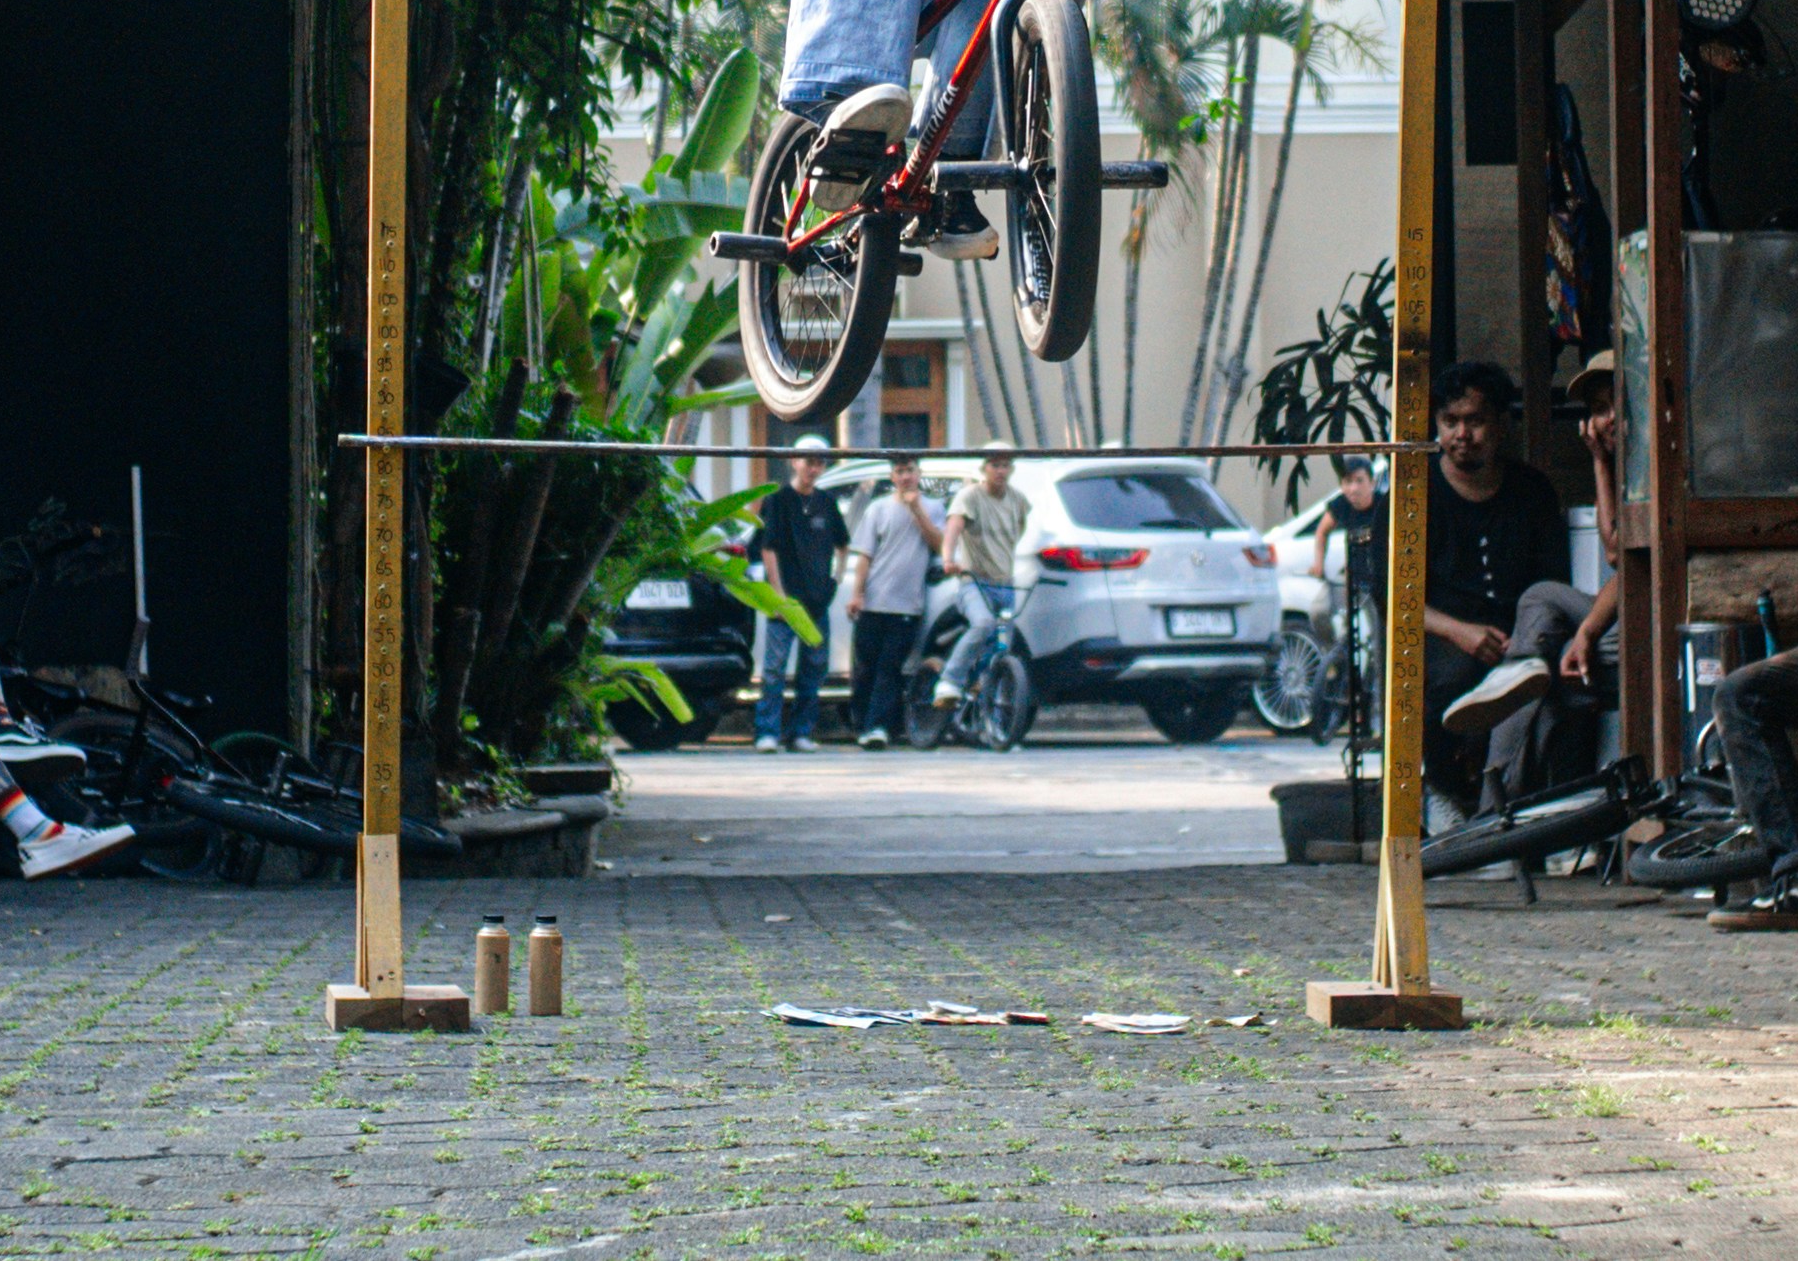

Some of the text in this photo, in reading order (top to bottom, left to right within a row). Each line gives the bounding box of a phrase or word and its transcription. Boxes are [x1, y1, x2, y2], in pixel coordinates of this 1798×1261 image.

[379, 258, 396, 272] 110
[1406, 266, 1426, 281] 110
[1404, 300, 1425, 315] 105
[378, 325, 399, 338] 100
[377, 357, 393, 373] 95
[376, 494, 394, 510] 75
[375, 528, 393, 542] 70
[1401, 530, 1419, 545] 70
[376, 560, 393, 576] 65
[1399, 563, 1419, 578] 65
[374, 594, 393, 609] 60
[373, 628, 396, 644] 55
[1394, 626, 1420, 647] 55
[372, 662, 395, 677] 50
[1394, 662, 1418, 679] 50
[373, 698, 391, 713] 45
[373, 763, 393, 781] 35
[1394, 762, 1413, 779] 35
